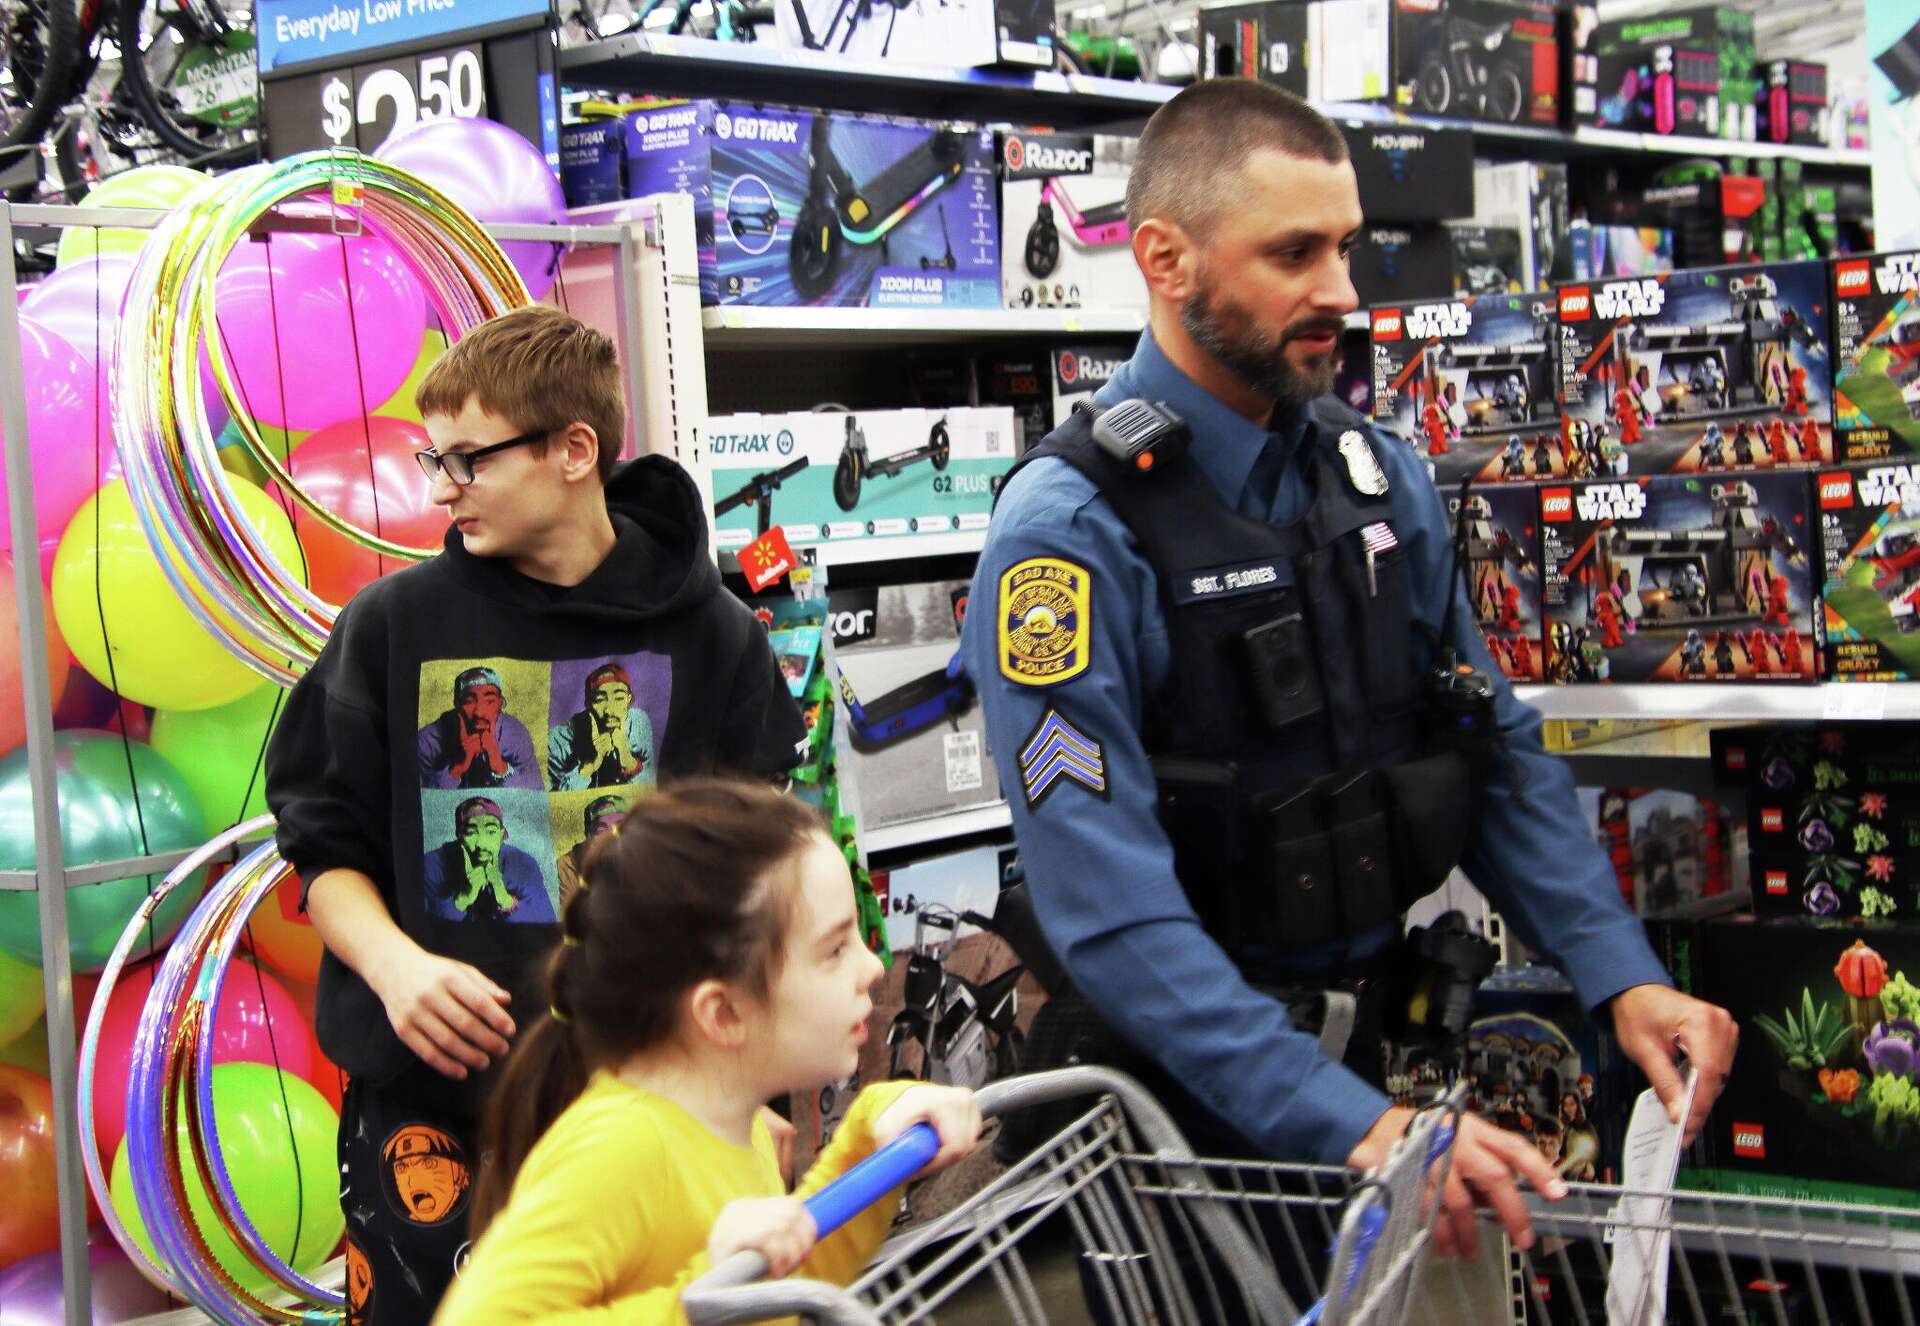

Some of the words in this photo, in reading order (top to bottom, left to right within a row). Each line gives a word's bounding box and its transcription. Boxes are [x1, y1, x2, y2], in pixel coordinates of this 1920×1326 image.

[276, 5, 360, 42] Everyday
[364, 0, 402, 25] Low
[186, 48, 257, 84] MOUNTAI
[649, 111, 697, 130] GOTRAX
[732, 117, 799, 143] GOTRAX
[1025, 141, 1091, 171] Razor
[1838, 270, 1868, 287] LEGO
[1560, 295, 1589, 313] LEGO
[1374, 317, 1401, 333] LEGO
[1078, 355, 1124, 380] Raz
[933, 475, 952, 493] G2
[954, 473, 989, 493] PLUS
[1820, 482, 1852, 499] LEGO
[1544, 497, 1571, 512] LEGO
[1012, 566, 1042, 586] BAD
[1046, 566, 1073, 586] AXE
[1191, 576, 1224, 595] SGT.
[1225, 565, 1278, 590] FLORES
[1015, 657, 1067, 675] POLICE
[1762, 815, 1783, 826] LEGO
[1766, 877, 1787, 888] LEGO
[1734, 1131, 1763, 1148] LEGO
